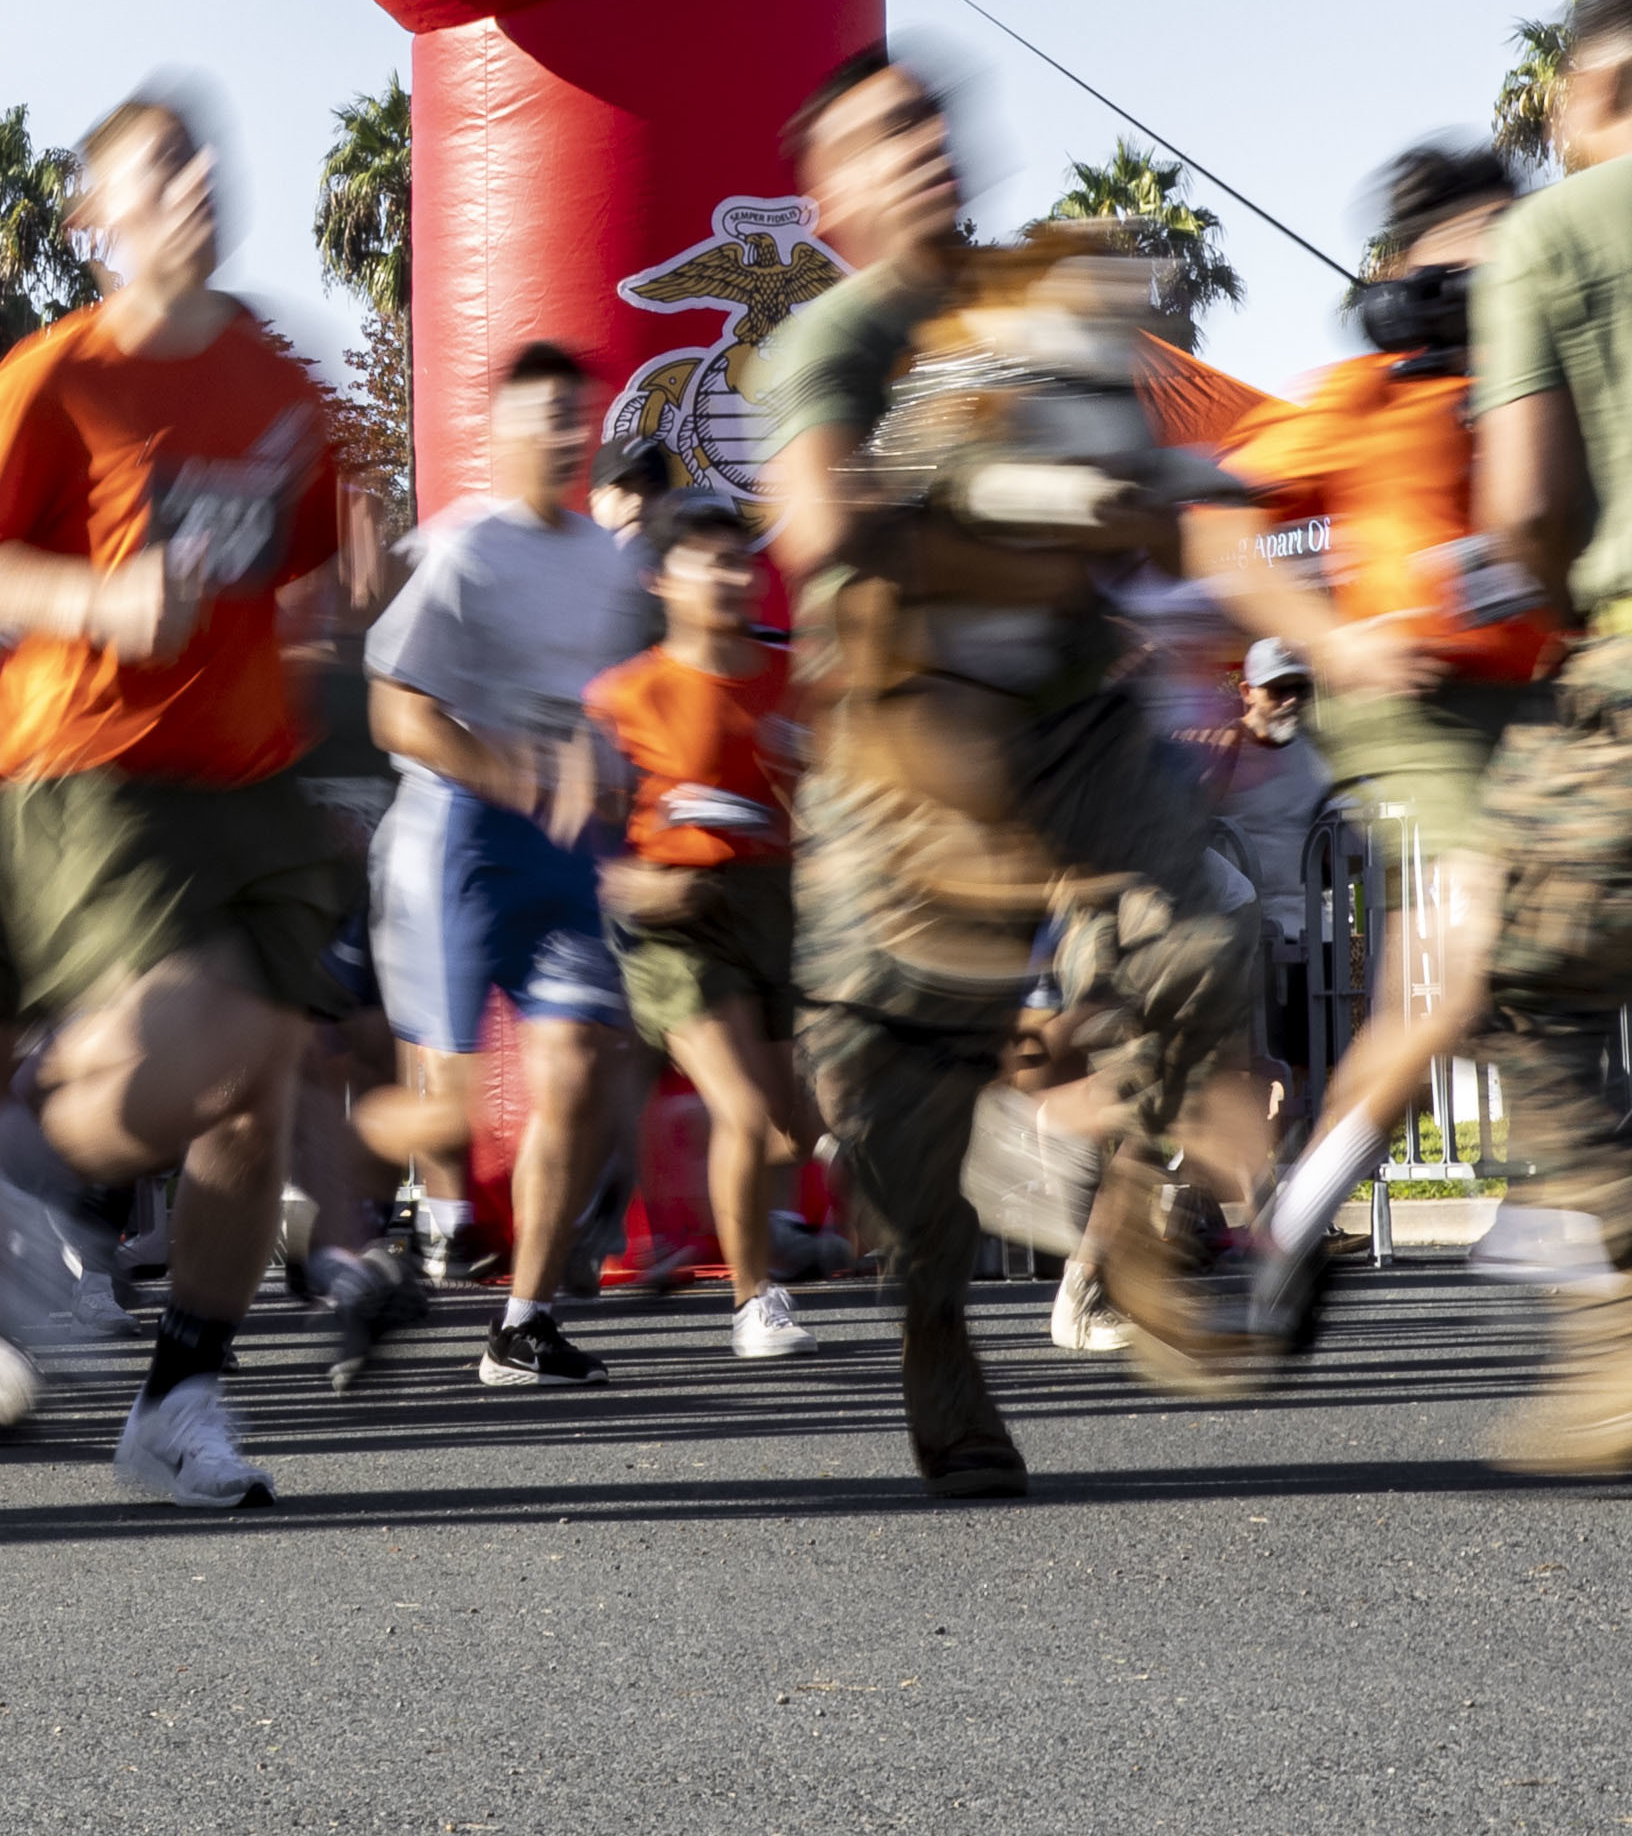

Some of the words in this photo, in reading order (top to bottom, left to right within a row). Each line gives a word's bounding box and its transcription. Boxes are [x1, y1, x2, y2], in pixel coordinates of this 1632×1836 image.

[729, 212, 765, 222] SEMPER
[766, 210, 797, 223] FIDELIS
[1254, 527, 1304, 568] Apart
